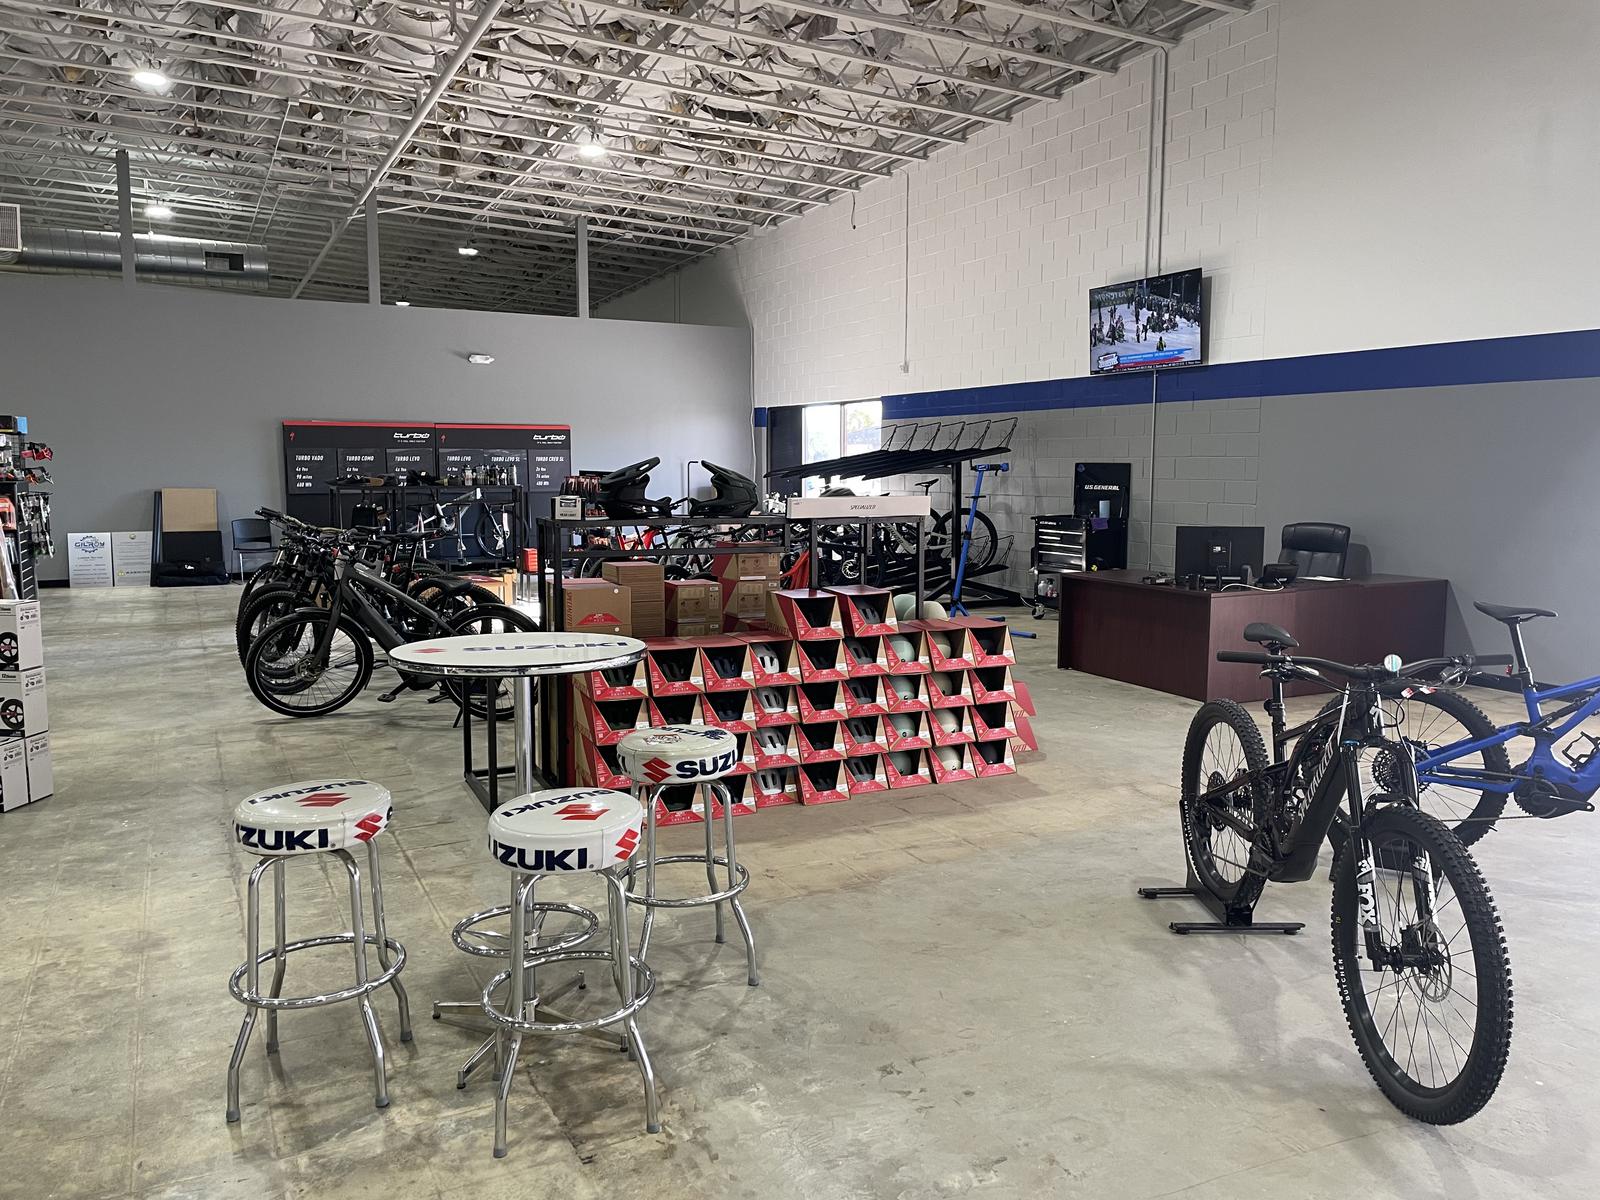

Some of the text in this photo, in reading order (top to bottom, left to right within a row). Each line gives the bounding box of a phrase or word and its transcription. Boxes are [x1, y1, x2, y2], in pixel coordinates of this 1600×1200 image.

[393, 432, 430, 440] turbo
[74, 541, 105, 549] GILROY
[462, 641, 628, 652] SUZUKI
[248, 780, 368, 805] SUZUKI
[1298, 741, 1334, 825] SPECIALIZED
[500, 789, 616, 818] SUZUKI
[1357, 882, 1378, 926] FOX
[1338, 958, 1351, 1002] BUTCHER
